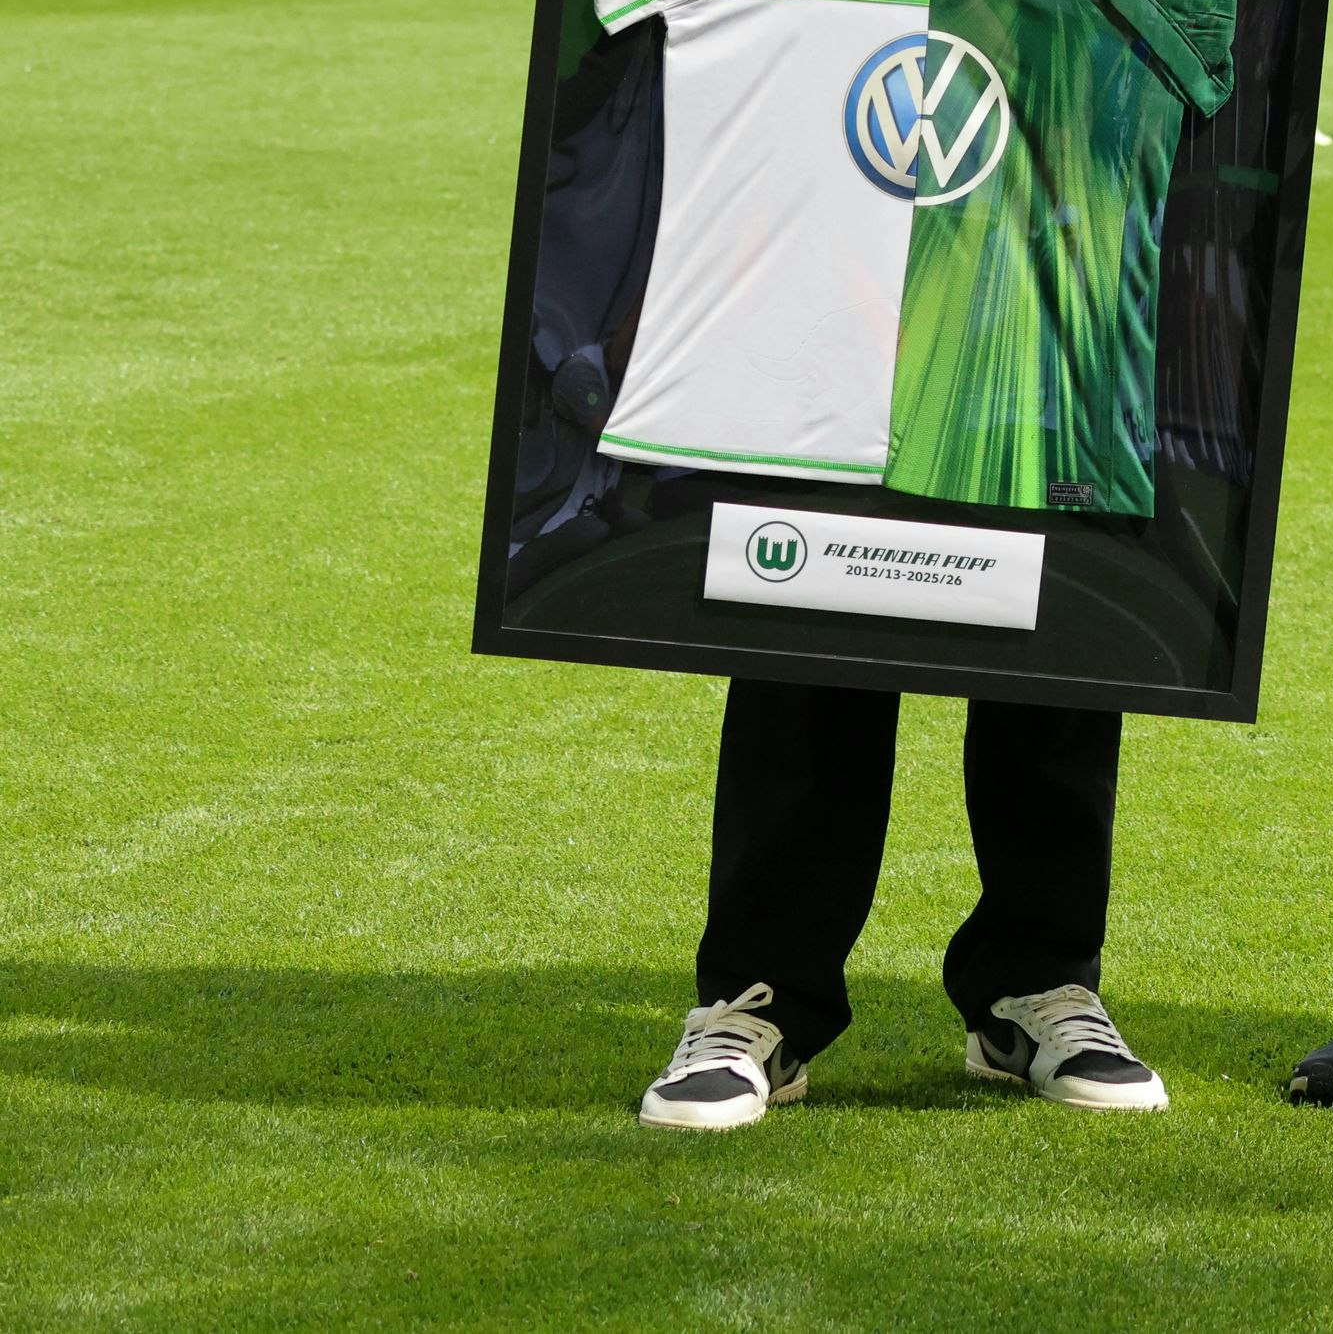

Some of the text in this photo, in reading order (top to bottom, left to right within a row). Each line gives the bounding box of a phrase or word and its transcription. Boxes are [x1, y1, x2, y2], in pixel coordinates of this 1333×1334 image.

[823, 542, 997, 572] ALEXANDRA POPP
[845, 564, 963, 586] 2012/13-2025/26
